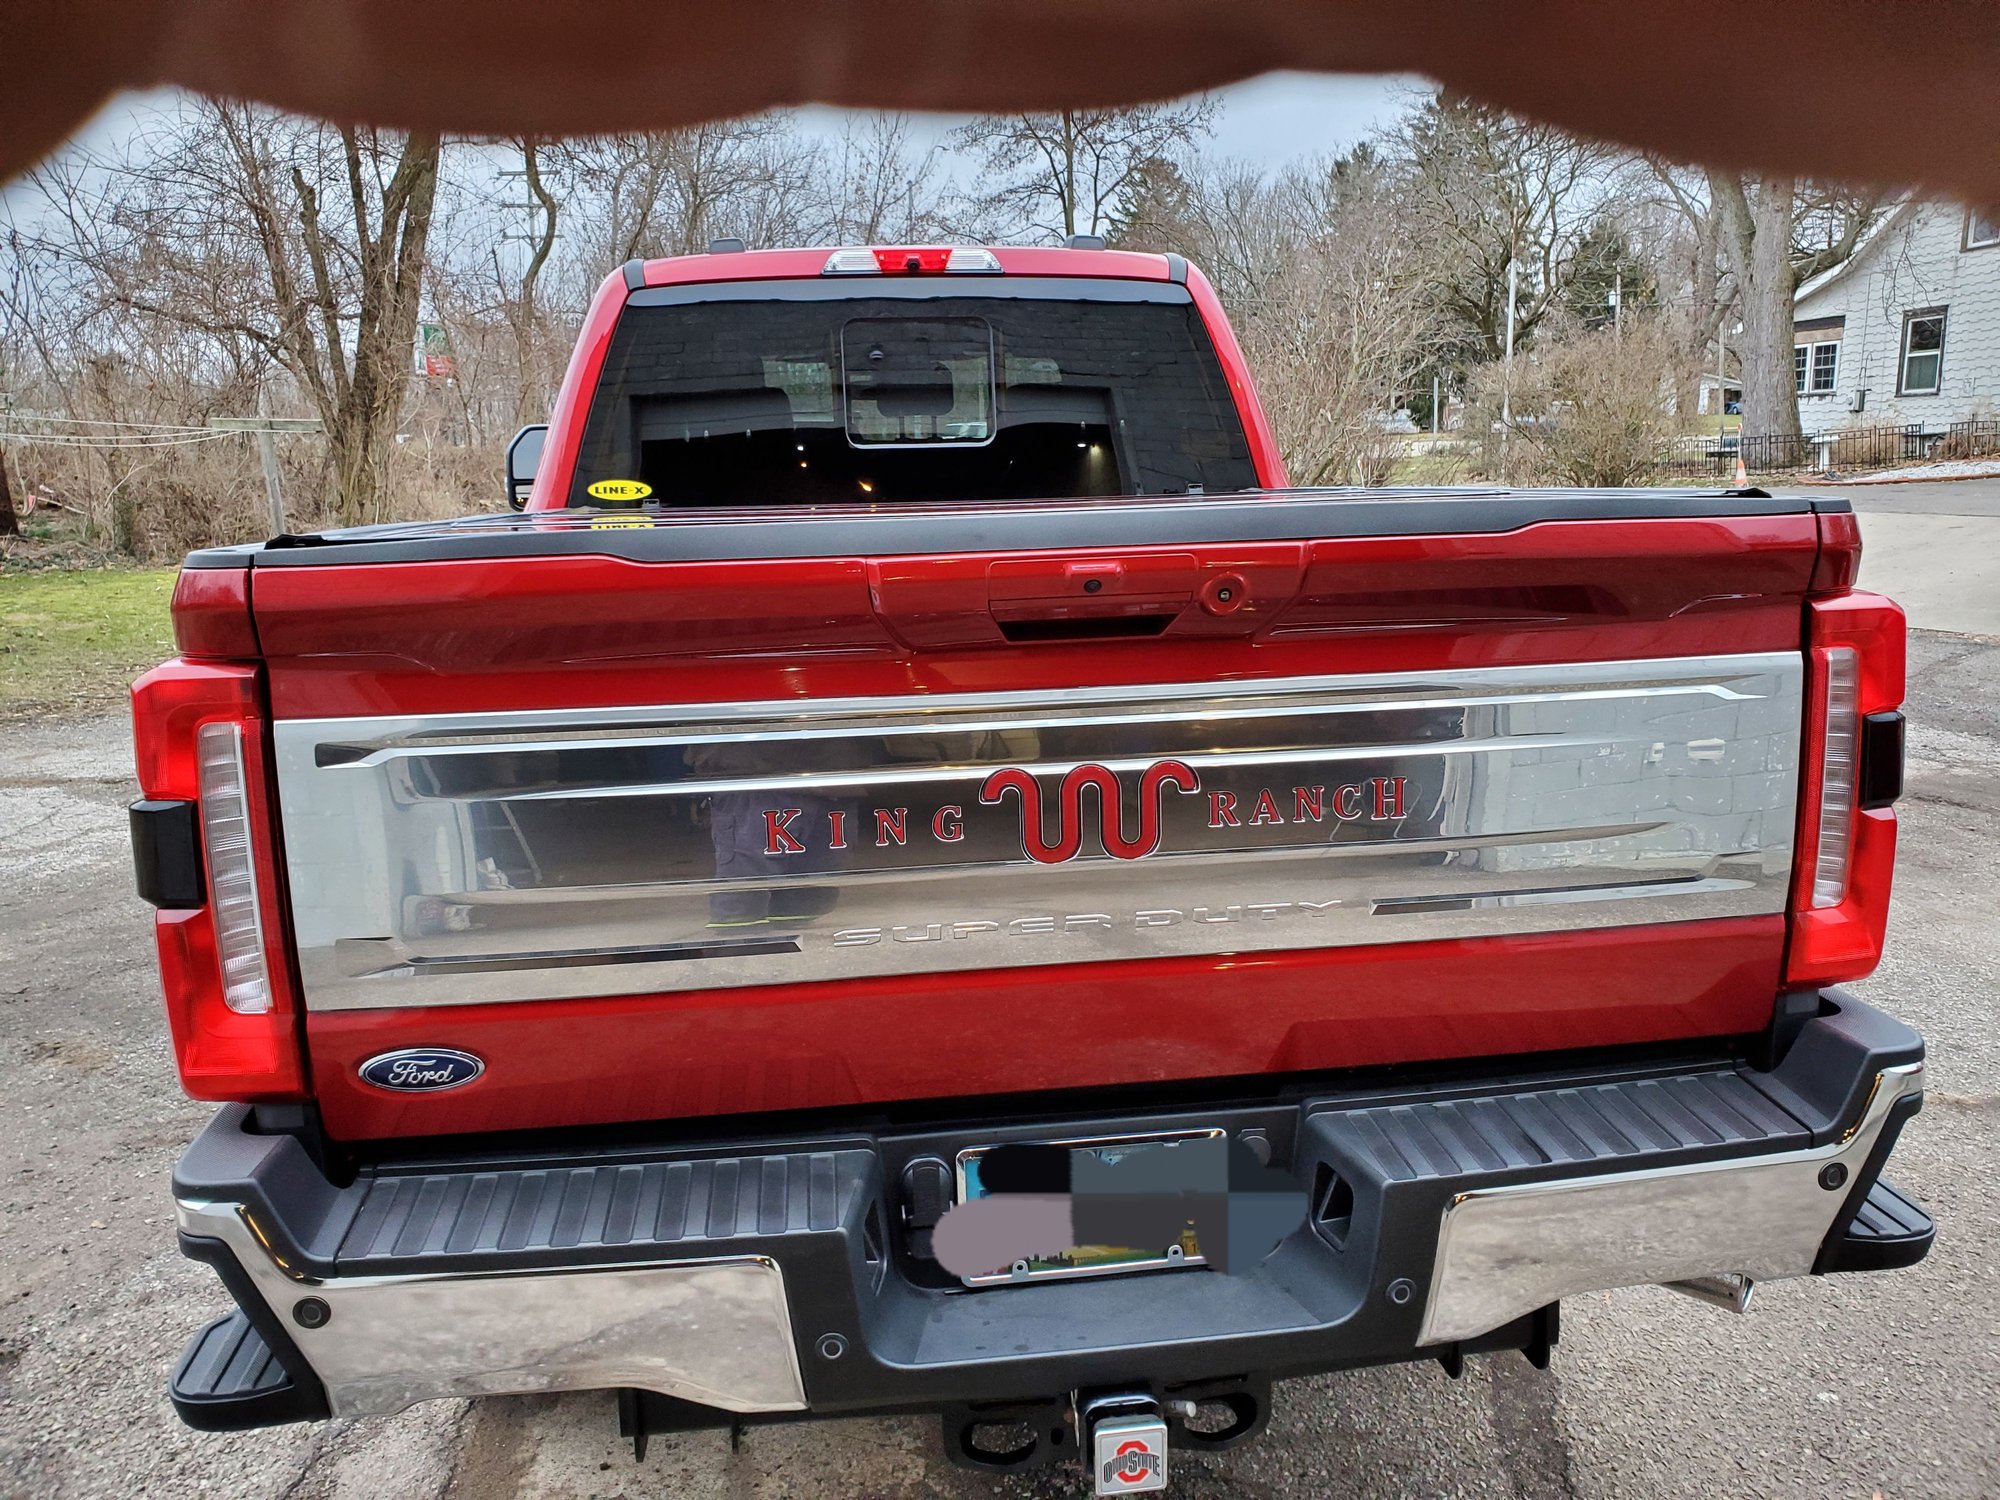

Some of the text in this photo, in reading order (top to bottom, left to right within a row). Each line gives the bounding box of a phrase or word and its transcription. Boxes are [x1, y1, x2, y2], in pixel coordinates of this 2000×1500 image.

[594, 486, 645, 495] LINE-X
[761, 776, 1408, 855] KING RANCH
[833, 899, 1342, 947] SUPER DUTY
[388, 1059, 454, 1085] Ford
